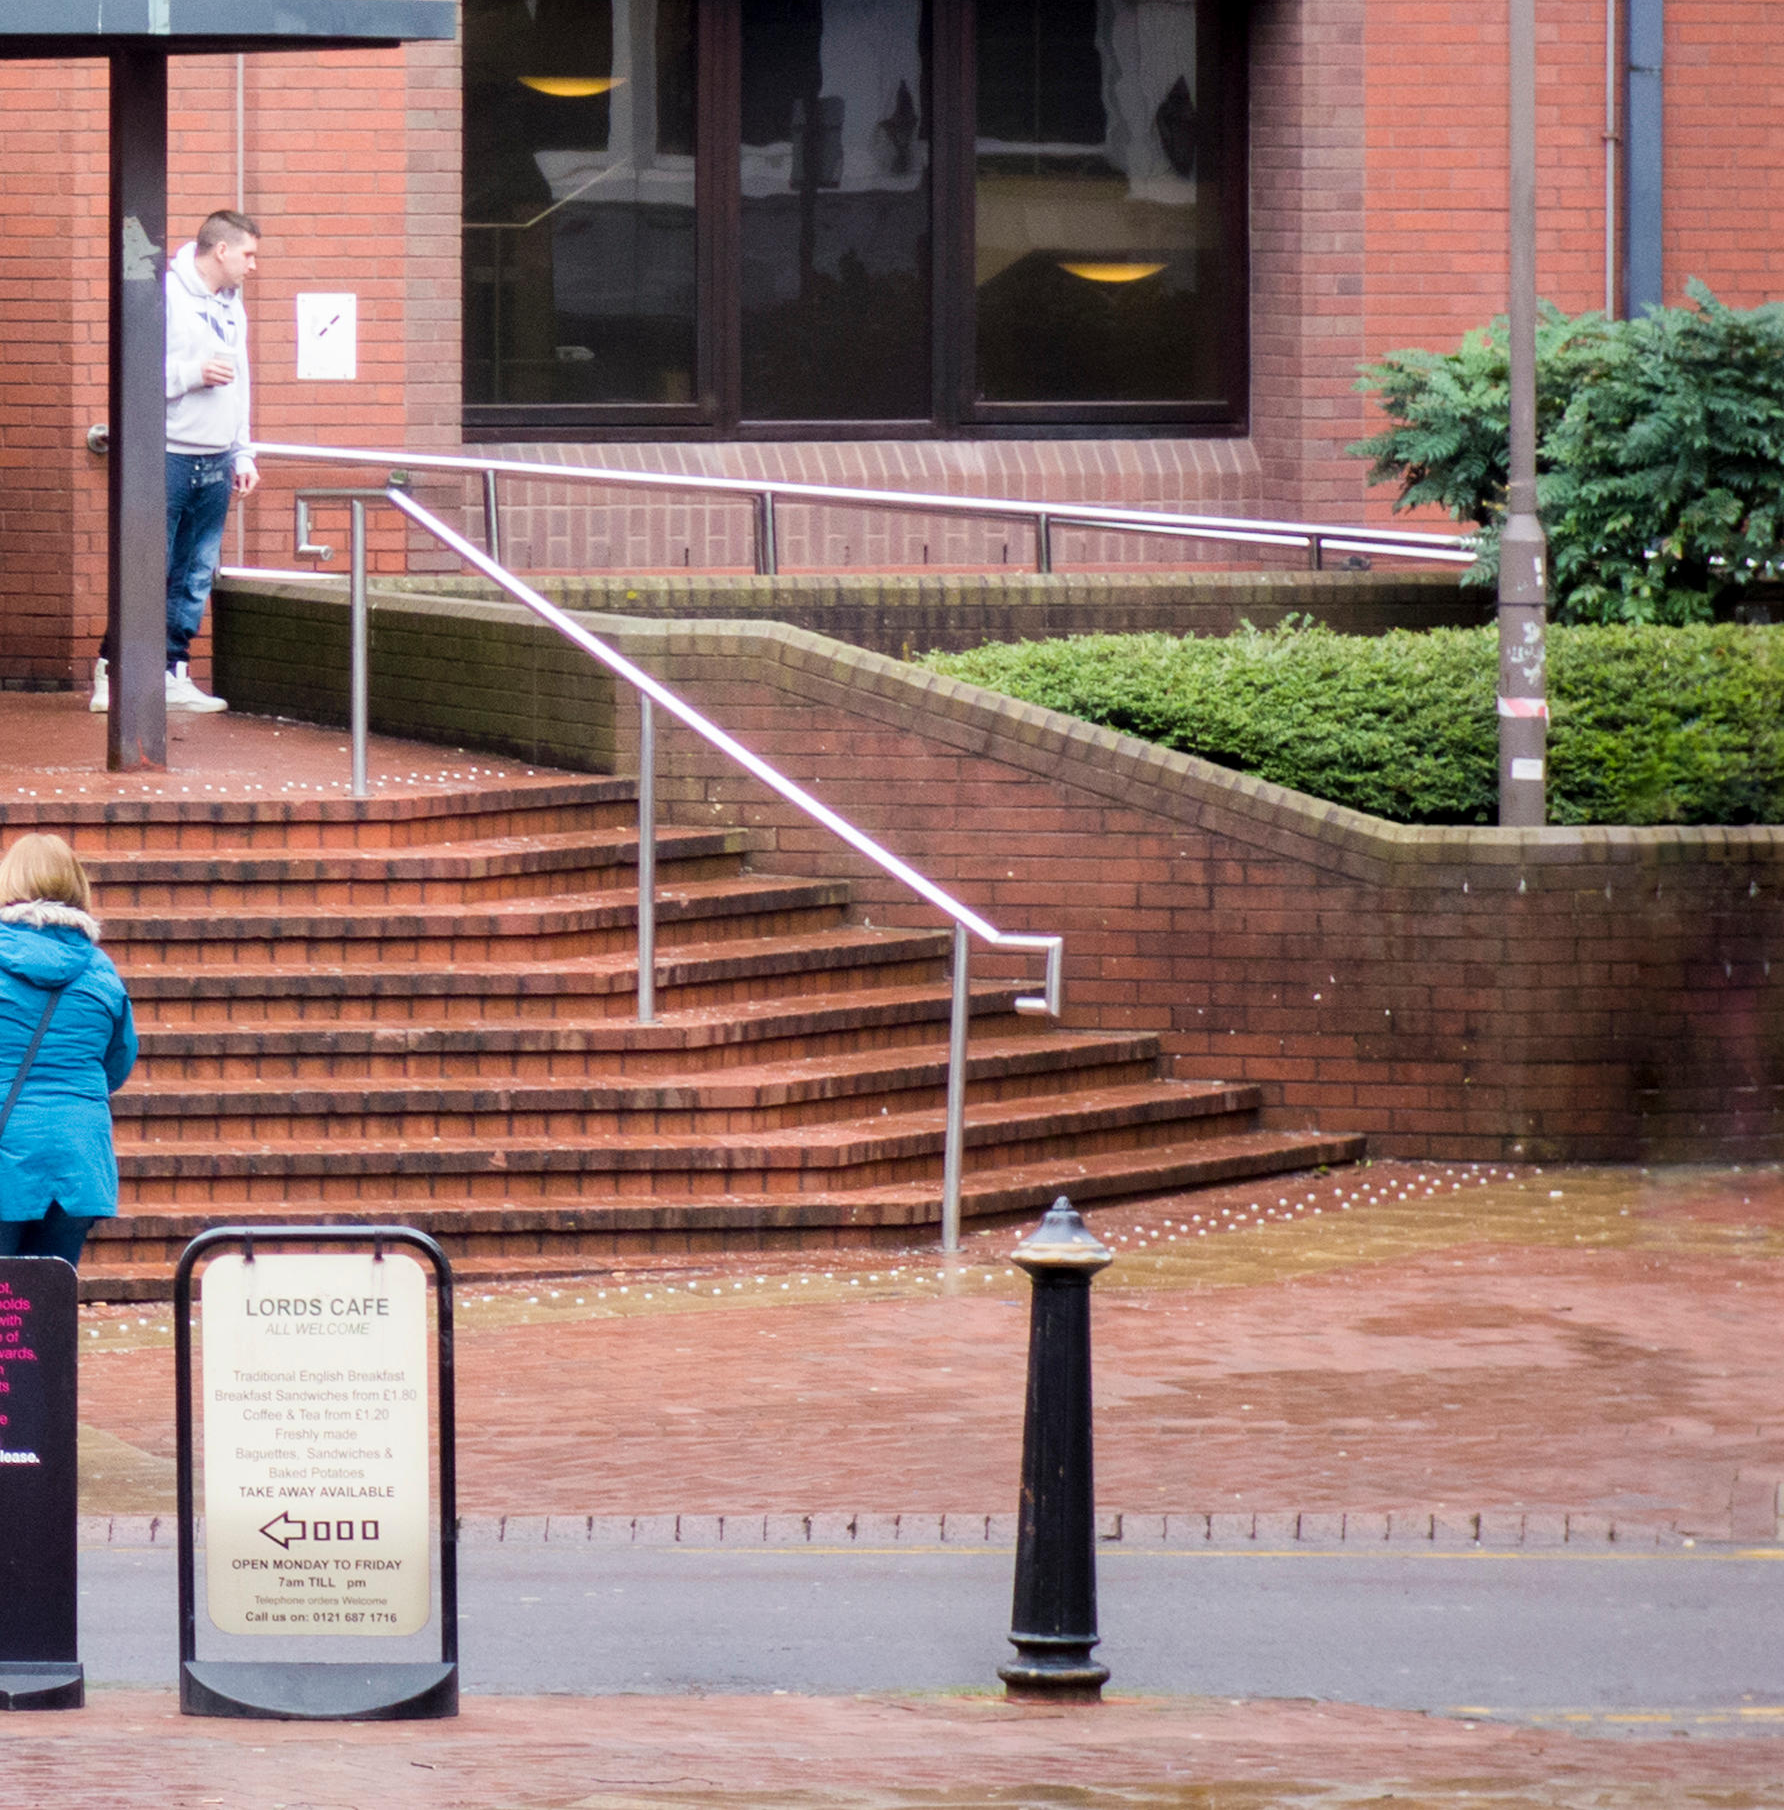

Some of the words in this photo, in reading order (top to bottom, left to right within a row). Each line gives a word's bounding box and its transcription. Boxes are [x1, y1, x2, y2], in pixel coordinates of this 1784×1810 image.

[245, 1298, 322, 1316] LORDS
[330, 1298, 390, 1316] CAFE
[265, 1322, 291, 1335] ALL
[295, 1322, 370, 1335] WELCOME
[5, 1330, 19, 1342] of
[233, 1370, 296, 1382] Traditional
[299, 1370, 344, 1385] English
[348, 1370, 405, 1382] Breakfast
[215, 1390, 272, 1401] Breakfast
[275, 1389, 348, 1401] Sandwiches
[352, 1389, 379, 1401] from
[383, 1390, 417, 1401] £1.80
[243, 1408, 282, 1421] Coffee
[286, 1409, 295, 1420] &
[299, 1408, 320, 1420] Tea
[324, 1408, 351, 1420] from
[355, 1408, 389, 1421] £1.20
[275, 1428, 319, 1441] Freshly
[323, 1428, 358, 1440] made
[306, 1447, 380, 1460] Sandwiches
[384, 1448, 393, 1460] &
[268, 1467, 307, 1479] Baked
[311, 1467, 365, 1479] Potatoes
[239, 1486, 274, 1498] TAKE
[278, 1486, 316, 1498] AWAY
[320, 1486, 395, 1498] AVAILABLE
[232, 1559, 269, 1570] OPEN
[273, 1559, 330, 1570] MONDAY
[333, 1559, 351, 1570] TO
[355, 1559, 402, 1571] FRIDAY
[278, 1576, 304, 1588] 7am
[308, 1577, 336, 1588] TILL
[347, 1579, 367, 1591] pm
[255, 1595, 305, 1606] Telephone
[308, 1595, 339, 1606] orders
[342, 1596, 388, 1606] Welcome
[245, 1611, 268, 1622] Call
[272, 1614, 286, 1622] us
[290, 1614, 309, 1622] on:
[313, 1612, 340, 1622] 0121
[345, 1613, 365, 1623] 687
[370, 1613, 397, 1623] 1716
